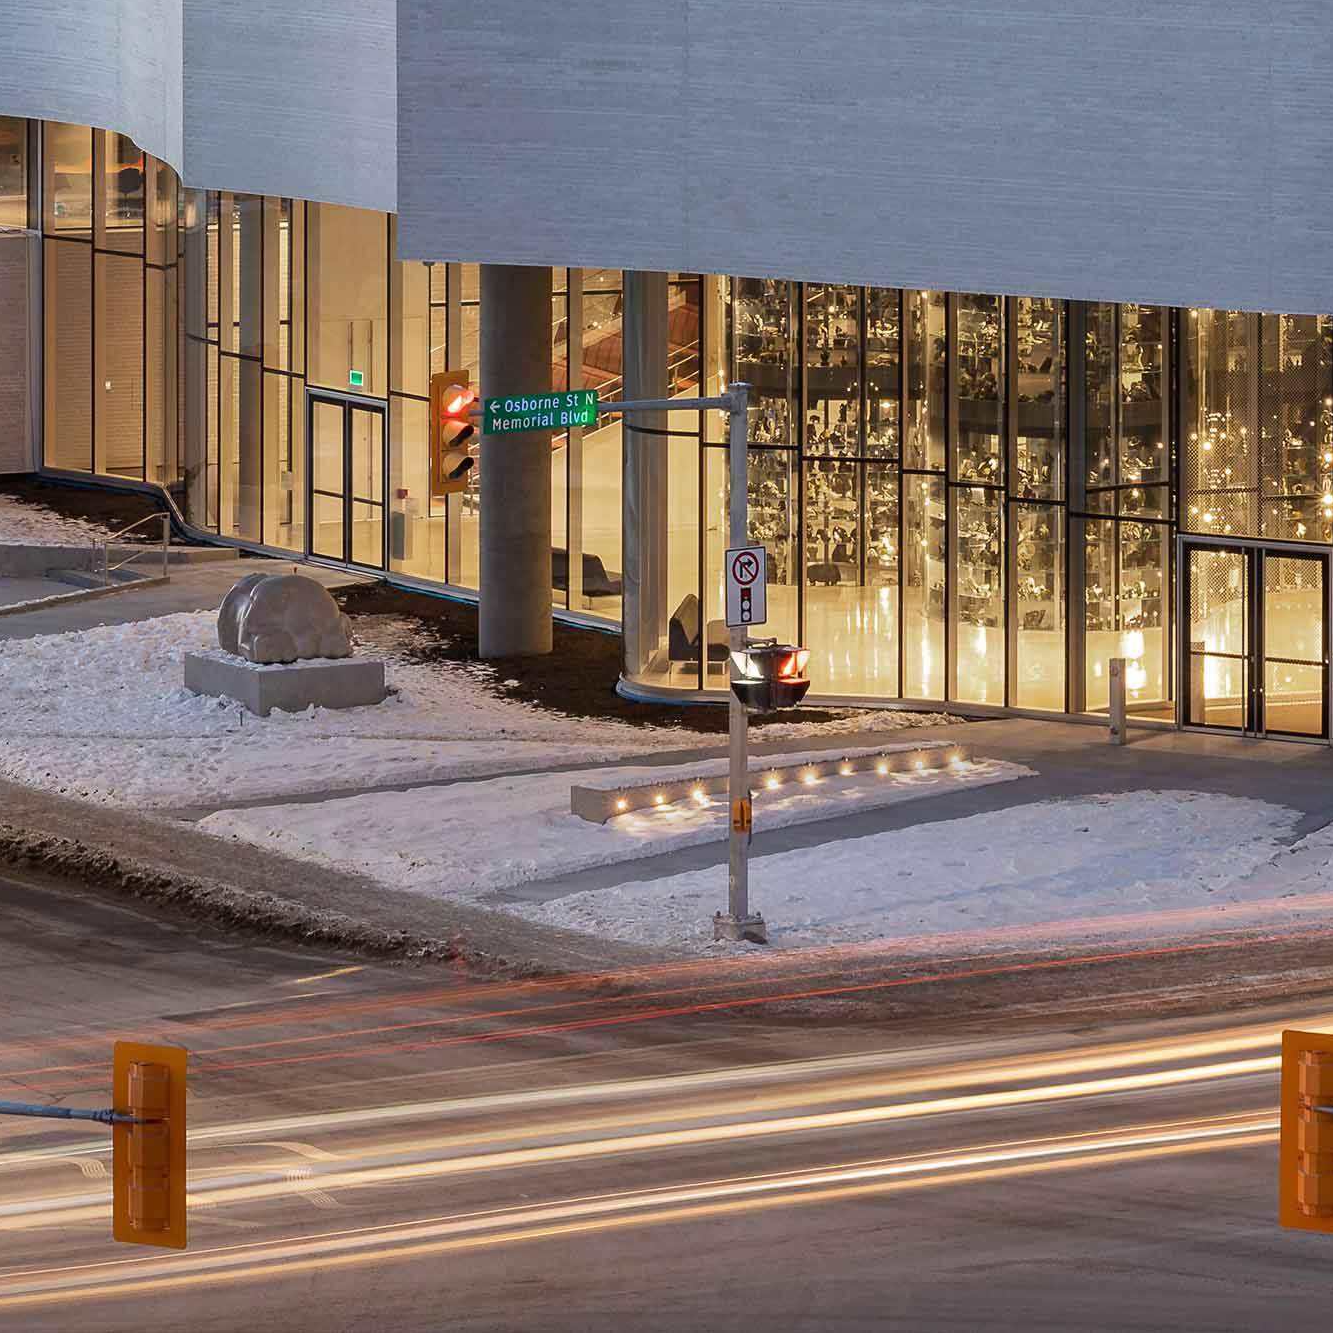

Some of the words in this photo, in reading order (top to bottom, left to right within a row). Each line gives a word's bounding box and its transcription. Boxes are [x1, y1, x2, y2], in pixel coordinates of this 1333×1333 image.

[504, 397, 560, 413] Osborne
[566, 394, 579, 407] St
[585, 392, 594, 405] N
[492, 413, 554, 431] Memorial
[560, 410, 588, 425] Blvd
